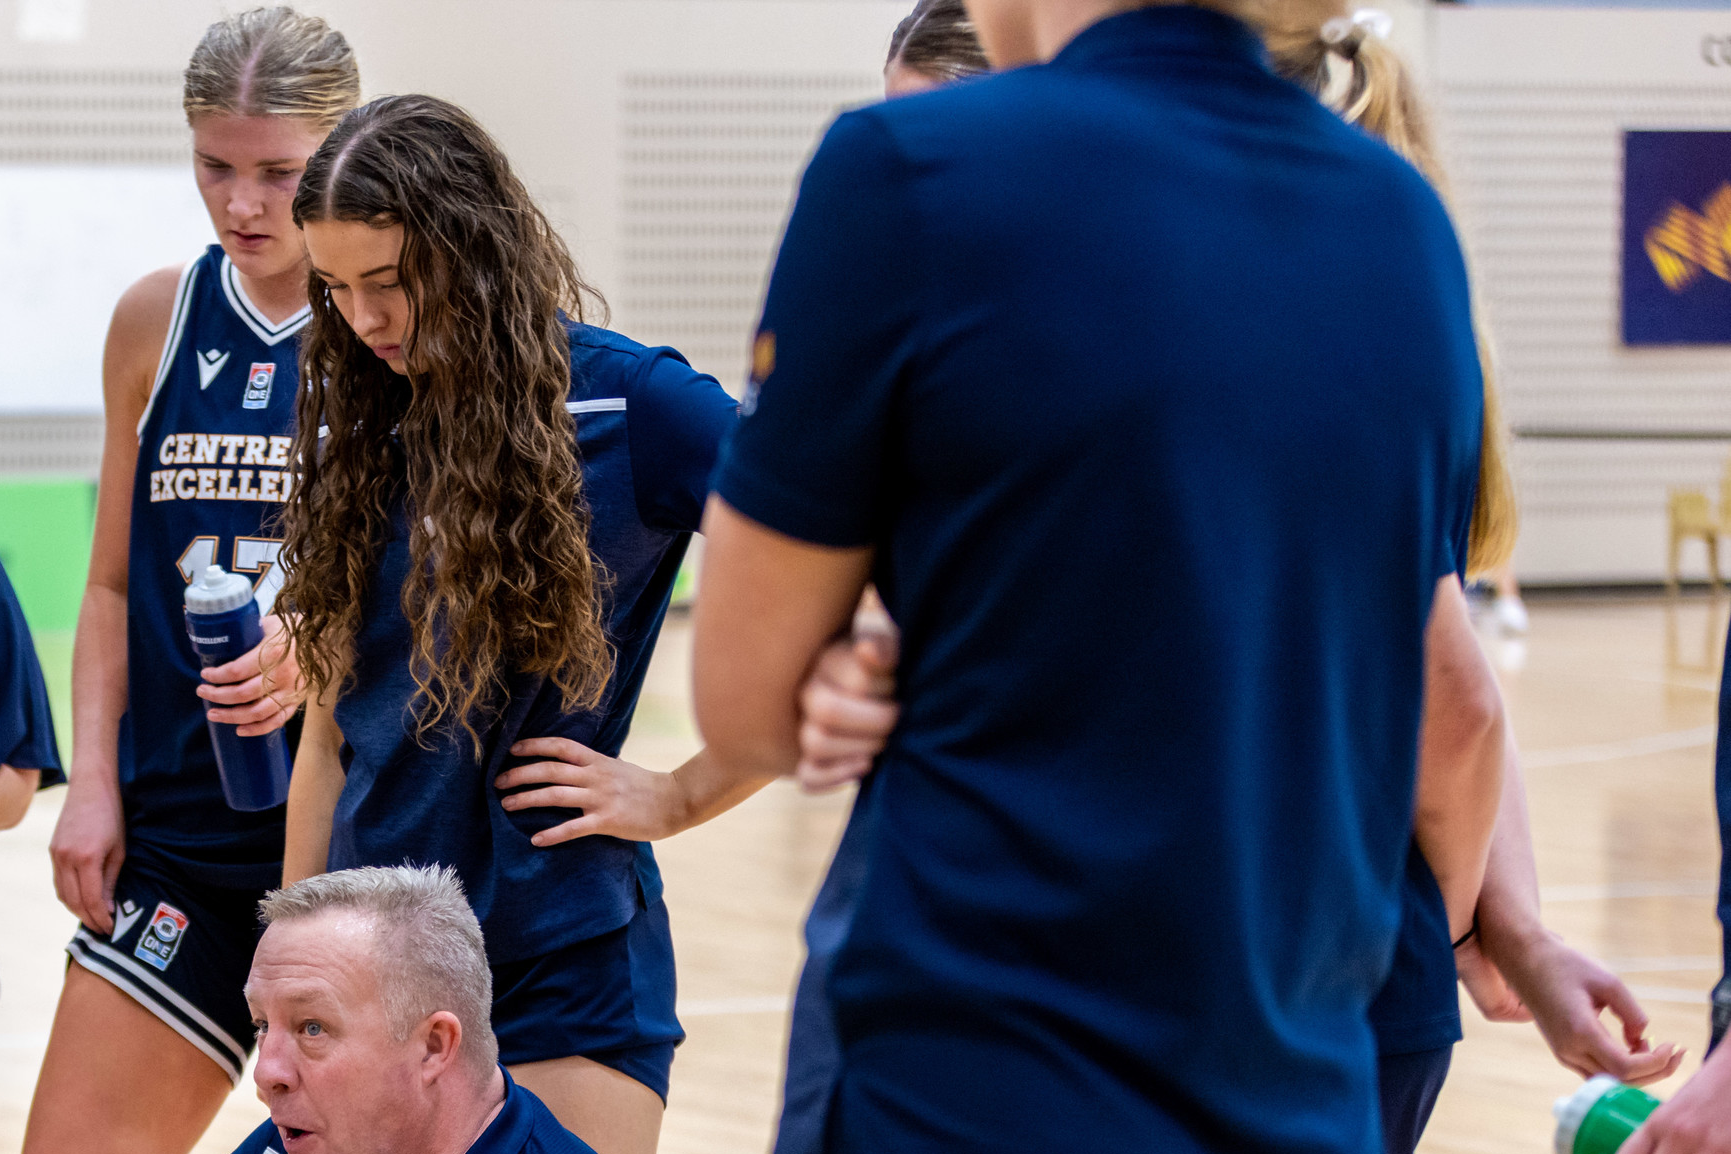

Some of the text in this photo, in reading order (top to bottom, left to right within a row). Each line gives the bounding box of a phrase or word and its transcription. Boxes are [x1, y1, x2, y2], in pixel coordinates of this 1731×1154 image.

[159, 433, 292, 466] CENTRE
[176, 535, 290, 618] 17
[144, 935, 171, 958] ONE
